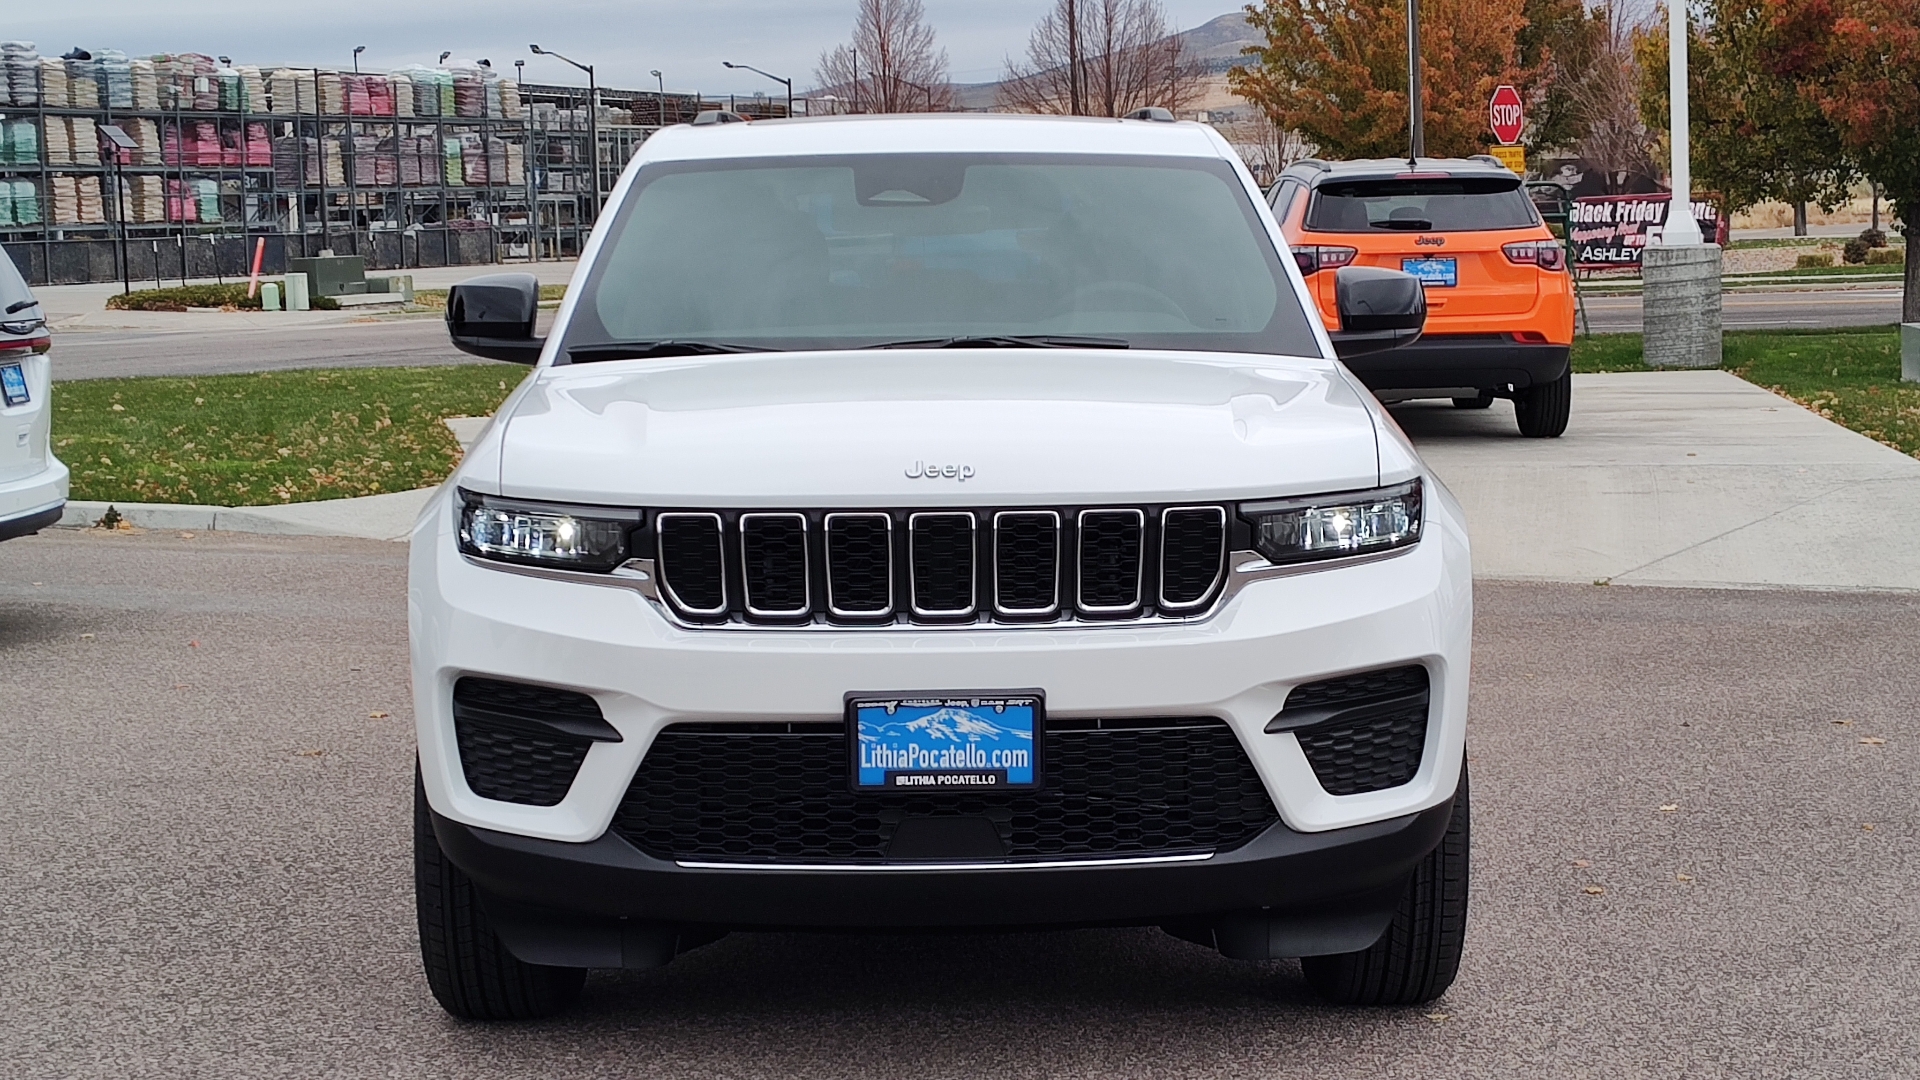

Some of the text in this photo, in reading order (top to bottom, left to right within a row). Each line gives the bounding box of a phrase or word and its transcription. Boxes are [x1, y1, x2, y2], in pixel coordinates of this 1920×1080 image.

[1493, 104, 1520, 126] STOP
[1570, 202, 1613, 222] Black
[1615, 200, 1665, 223] Friday
[1414, 235, 1445, 247] Jeep
[1580, 246, 1642, 261] ASHLEY
[904, 460, 976, 482] Jeep
[861, 743, 1028, 768] LithiaPocatello.com
[905, 774, 996, 786] LITHIA POCATELLO
